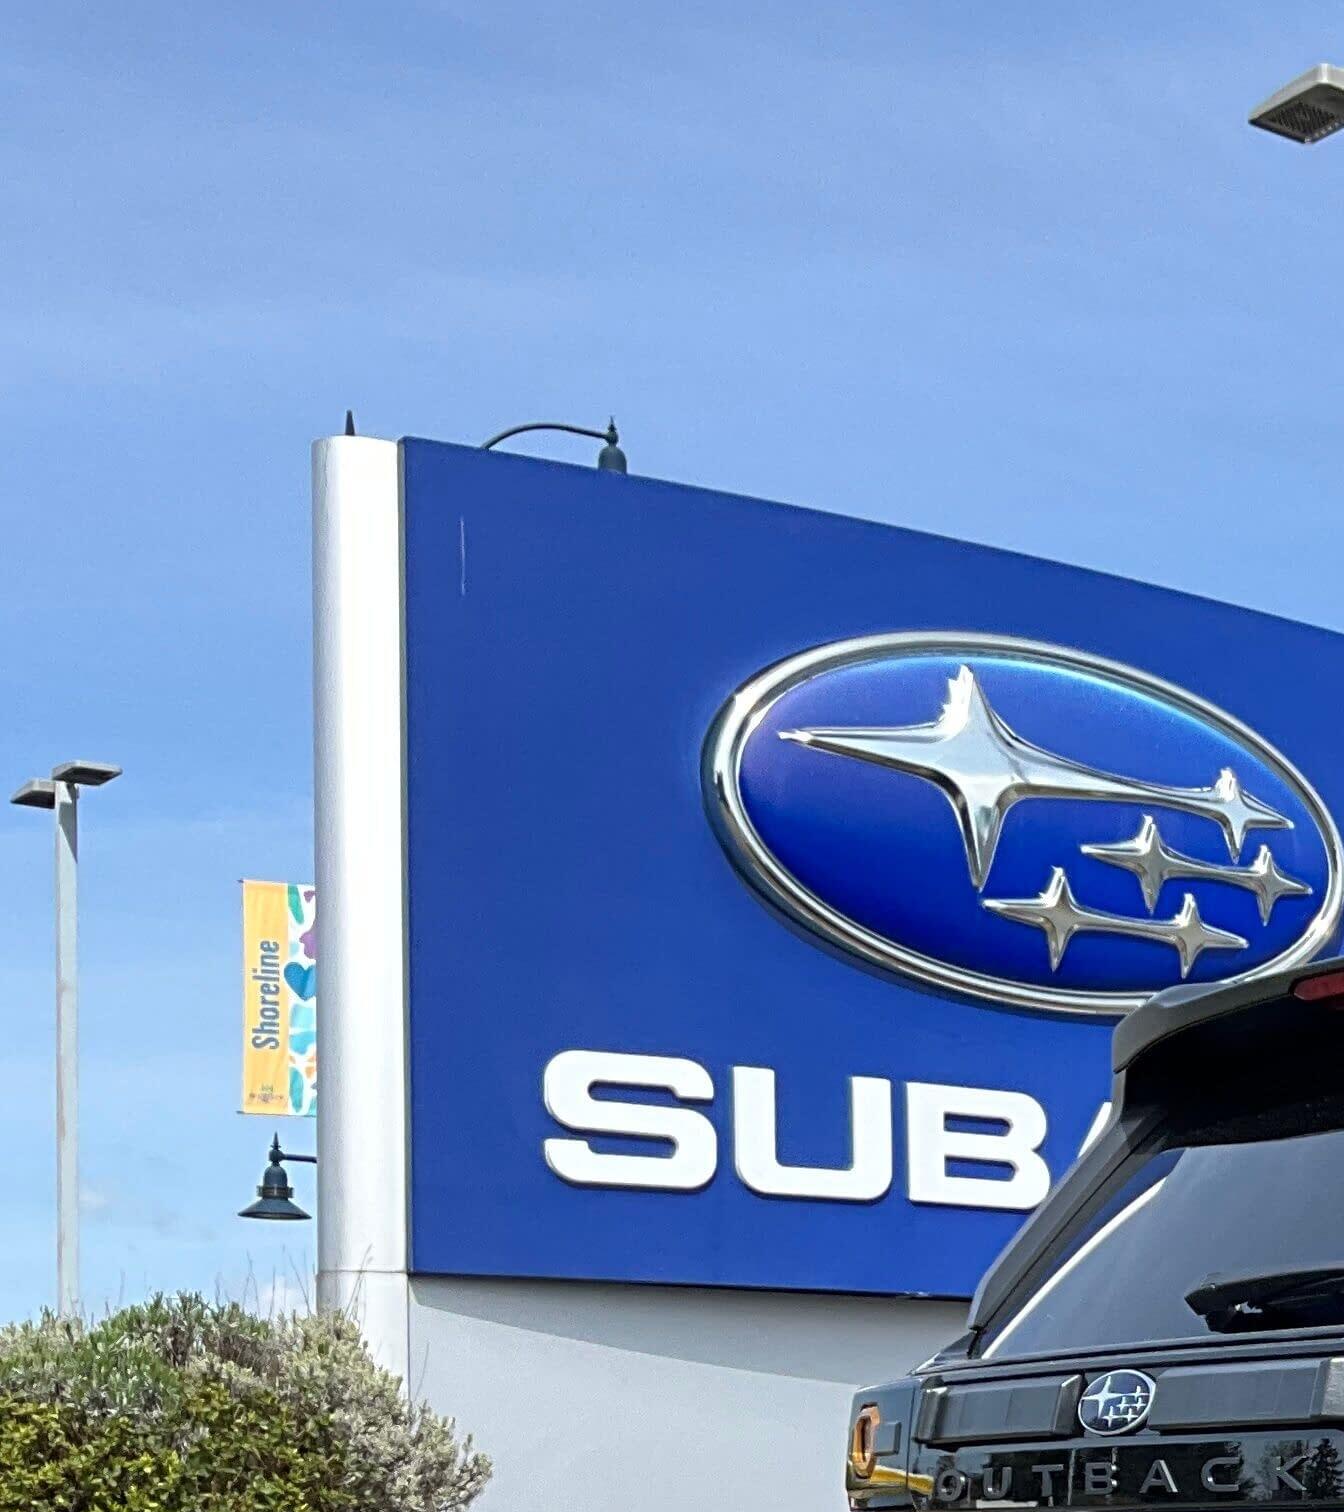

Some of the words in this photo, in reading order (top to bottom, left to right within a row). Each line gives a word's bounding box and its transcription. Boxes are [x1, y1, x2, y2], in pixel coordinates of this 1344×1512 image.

[251, 939, 280, 1051] Shoreline
[543, 1049, 1113, 1211] SUB
[934, 1454, 1307, 1500] OUTBACK
